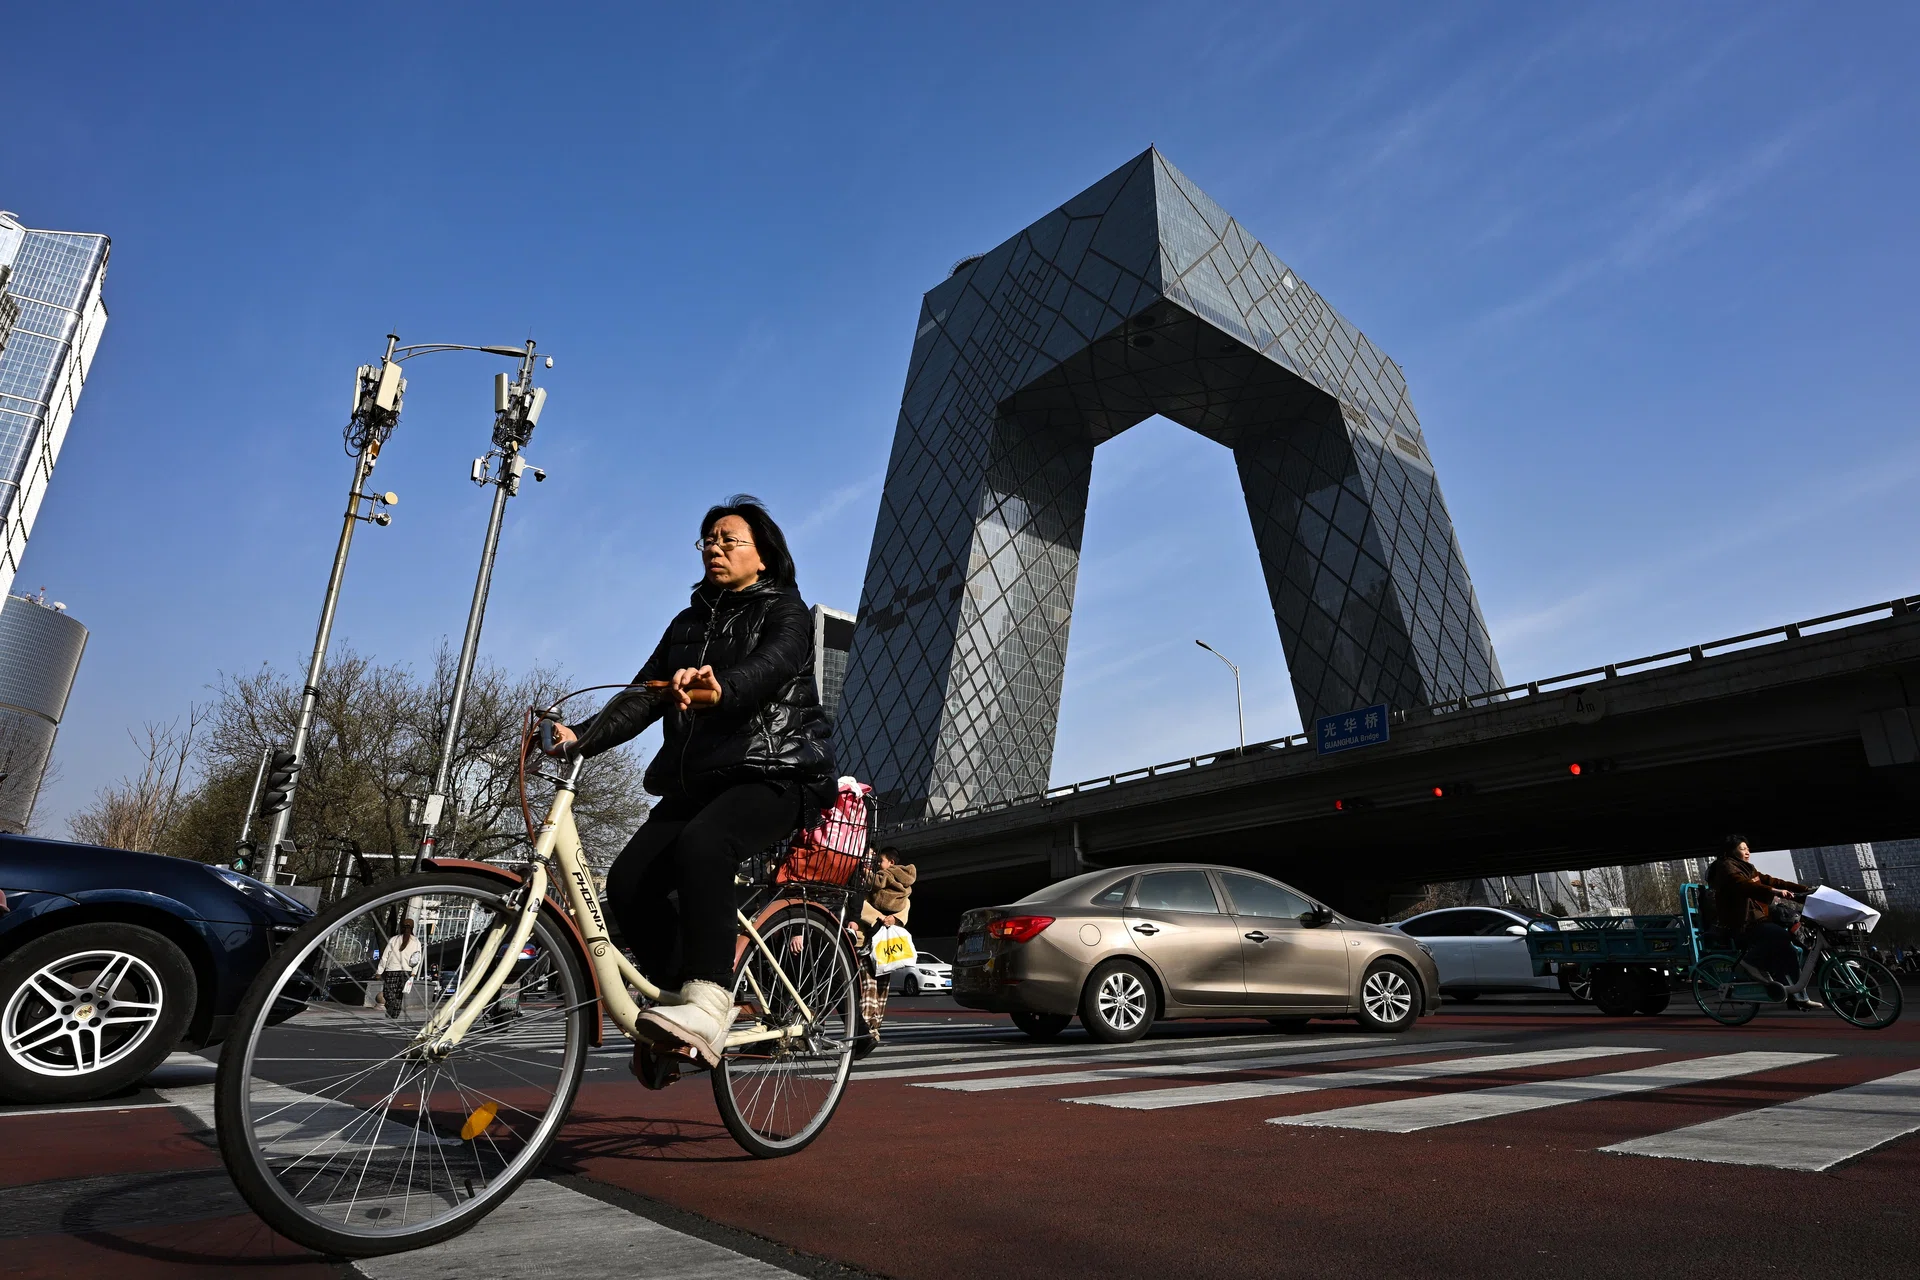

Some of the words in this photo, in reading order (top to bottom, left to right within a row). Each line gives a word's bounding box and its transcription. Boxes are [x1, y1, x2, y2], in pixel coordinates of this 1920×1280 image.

[1324, 712, 1378, 738] 光华桥
[1324, 736, 1360, 749] GUANGHUA
[1360, 733, 1380, 741] Bridge
[572, 871, 606, 932] PHOENIX
[884, 943, 903, 958] KKV
